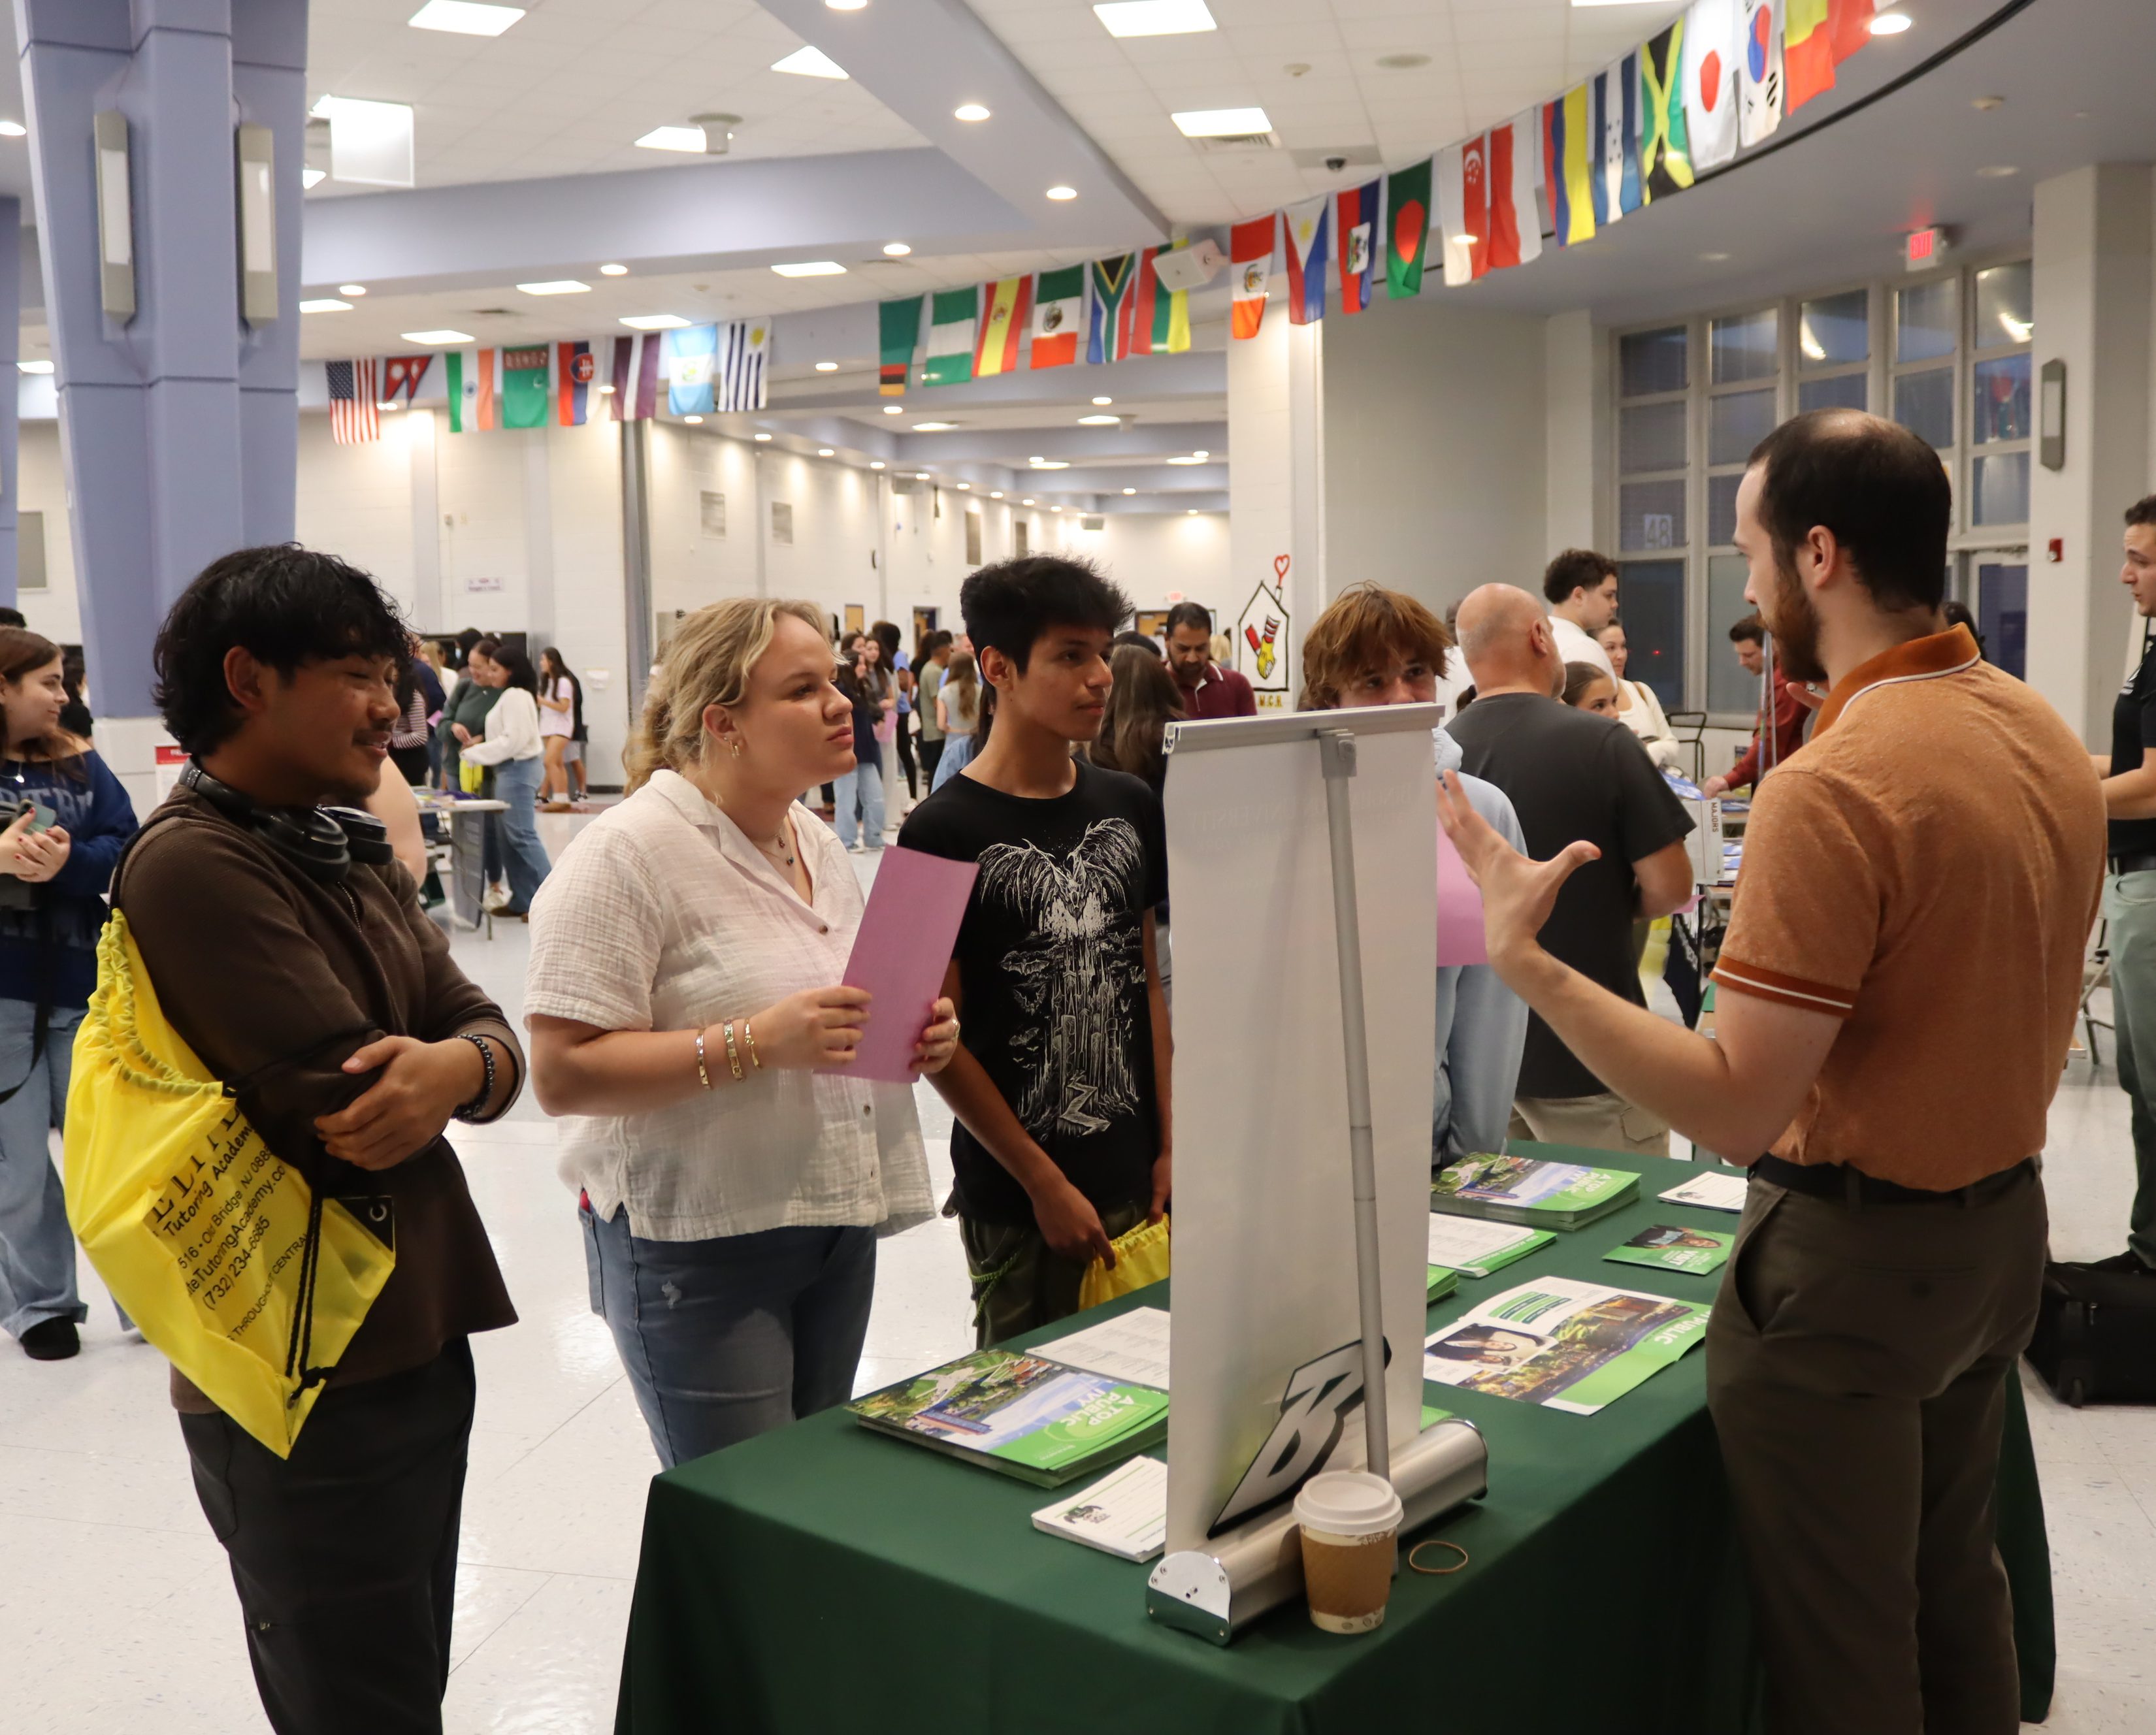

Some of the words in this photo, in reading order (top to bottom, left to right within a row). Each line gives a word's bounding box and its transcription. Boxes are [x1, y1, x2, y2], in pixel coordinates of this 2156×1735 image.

[1646, 517, 1671, 547] 48
[163, 1180, 214, 1237] Tutoring
[212, 1120, 255, 1181] Academ
[1565, 1172, 1601, 1193] PUBLIC
[1586, 1180, 1607, 1192] TOP
[177, 1246, 199, 1269] 516
[202, 1222, 216, 1244] Old
[211, 1190, 242, 1227] Bridge
[240, 1170, 253, 1190] NJ
[202, 1273, 236, 1311] (732)
[228, 1215, 270, 1278] 234-6685
[232, 1273, 276, 1337] THROUGHOUT
[272, 1233, 308, 1274] CENTRA
[1654, 1316, 1708, 1345] PUBLIC
[1060, 1391, 1121, 1427] PUBLIC
[1077, 1387, 1107, 1407] IVY
[1117, 1395, 1135, 1405] A
[1088, 1405, 1123, 1425] TOP
